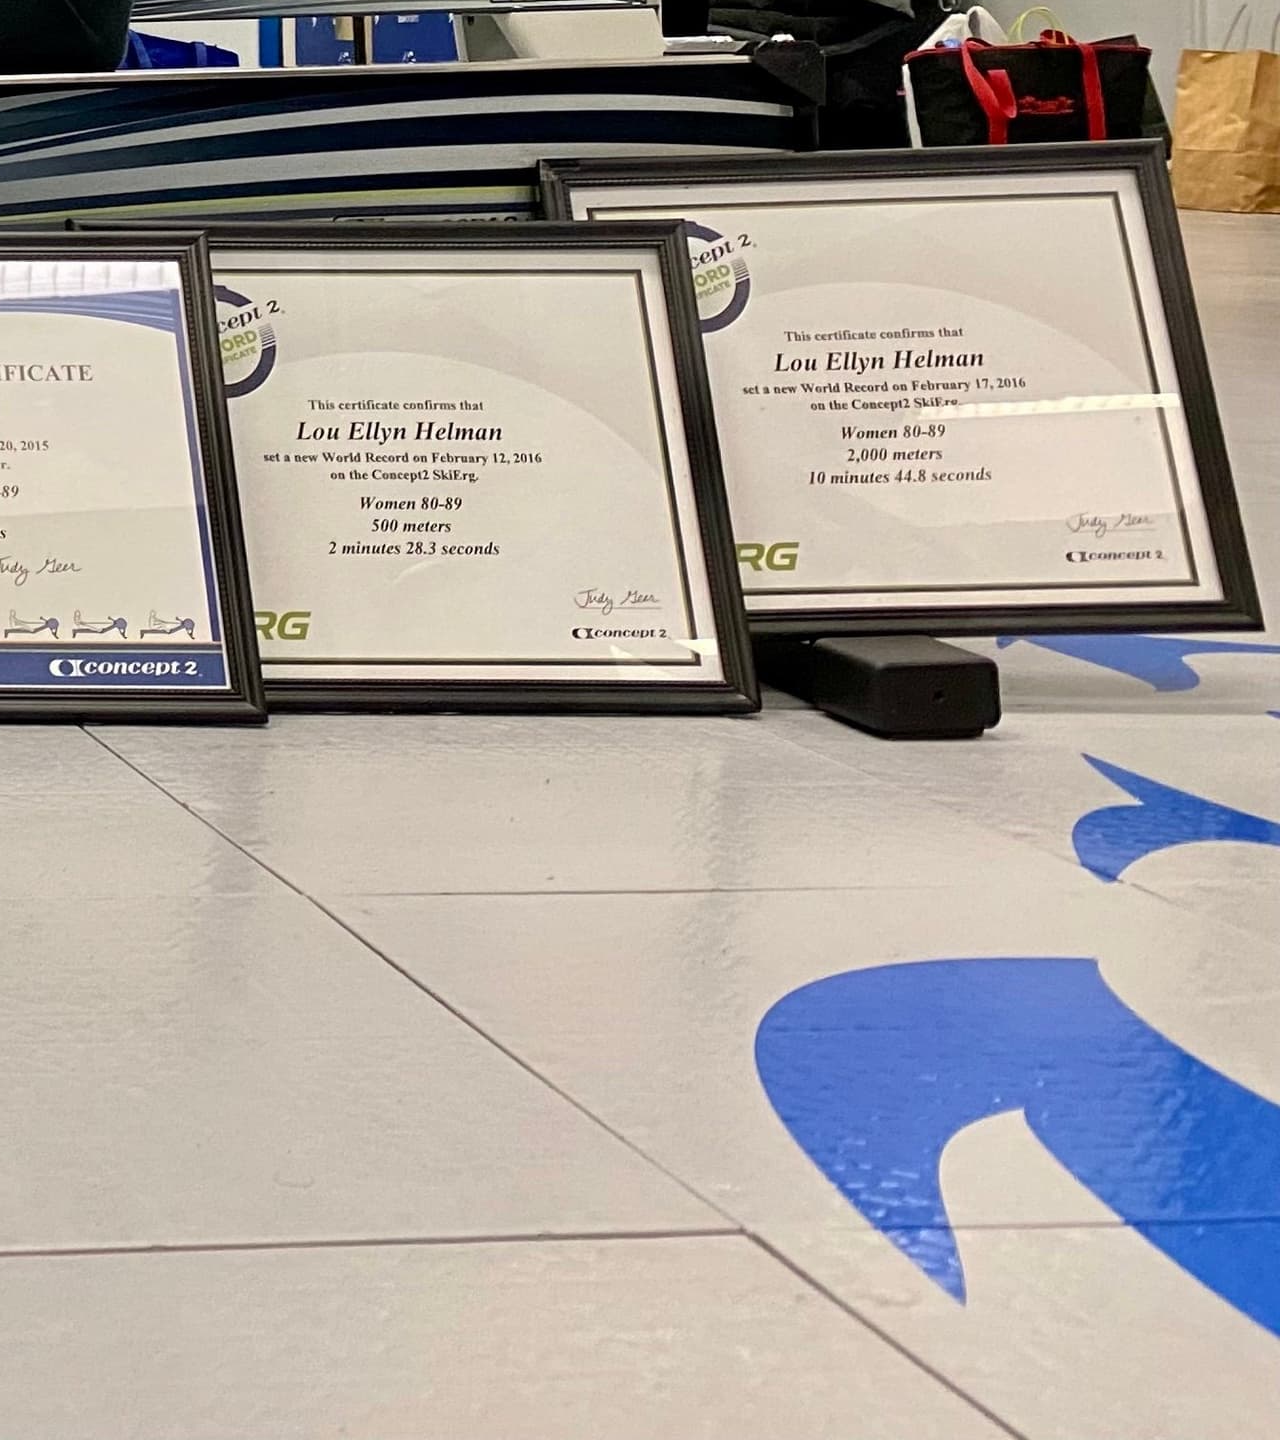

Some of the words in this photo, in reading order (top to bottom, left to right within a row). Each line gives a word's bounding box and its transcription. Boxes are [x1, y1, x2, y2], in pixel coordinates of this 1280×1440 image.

[774, 351, 818, 371] Lou
[825, 350, 885, 376] Ellyn
[892, 348, 984, 369] Helman
[296, 421, 340, 440] Lou
[347, 421, 407, 445] Ellyn
[413, 421, 502, 440] Helman
[809, 470, 826, 484] 10
[830, 469, 890, 484] minutes
[894, 467, 927, 483] 44.8
[931, 465, 992, 482] seconds
[328, 540, 337, 554] 2
[341, 540, 402, 554] minutes
[405, 540, 437, 555] 28.3
[440, 541, 500, 555] seconds
[594, 628, 657, 639] concept
[83, 660, 181, 676] concept
[184, 660, 198, 676] 2
